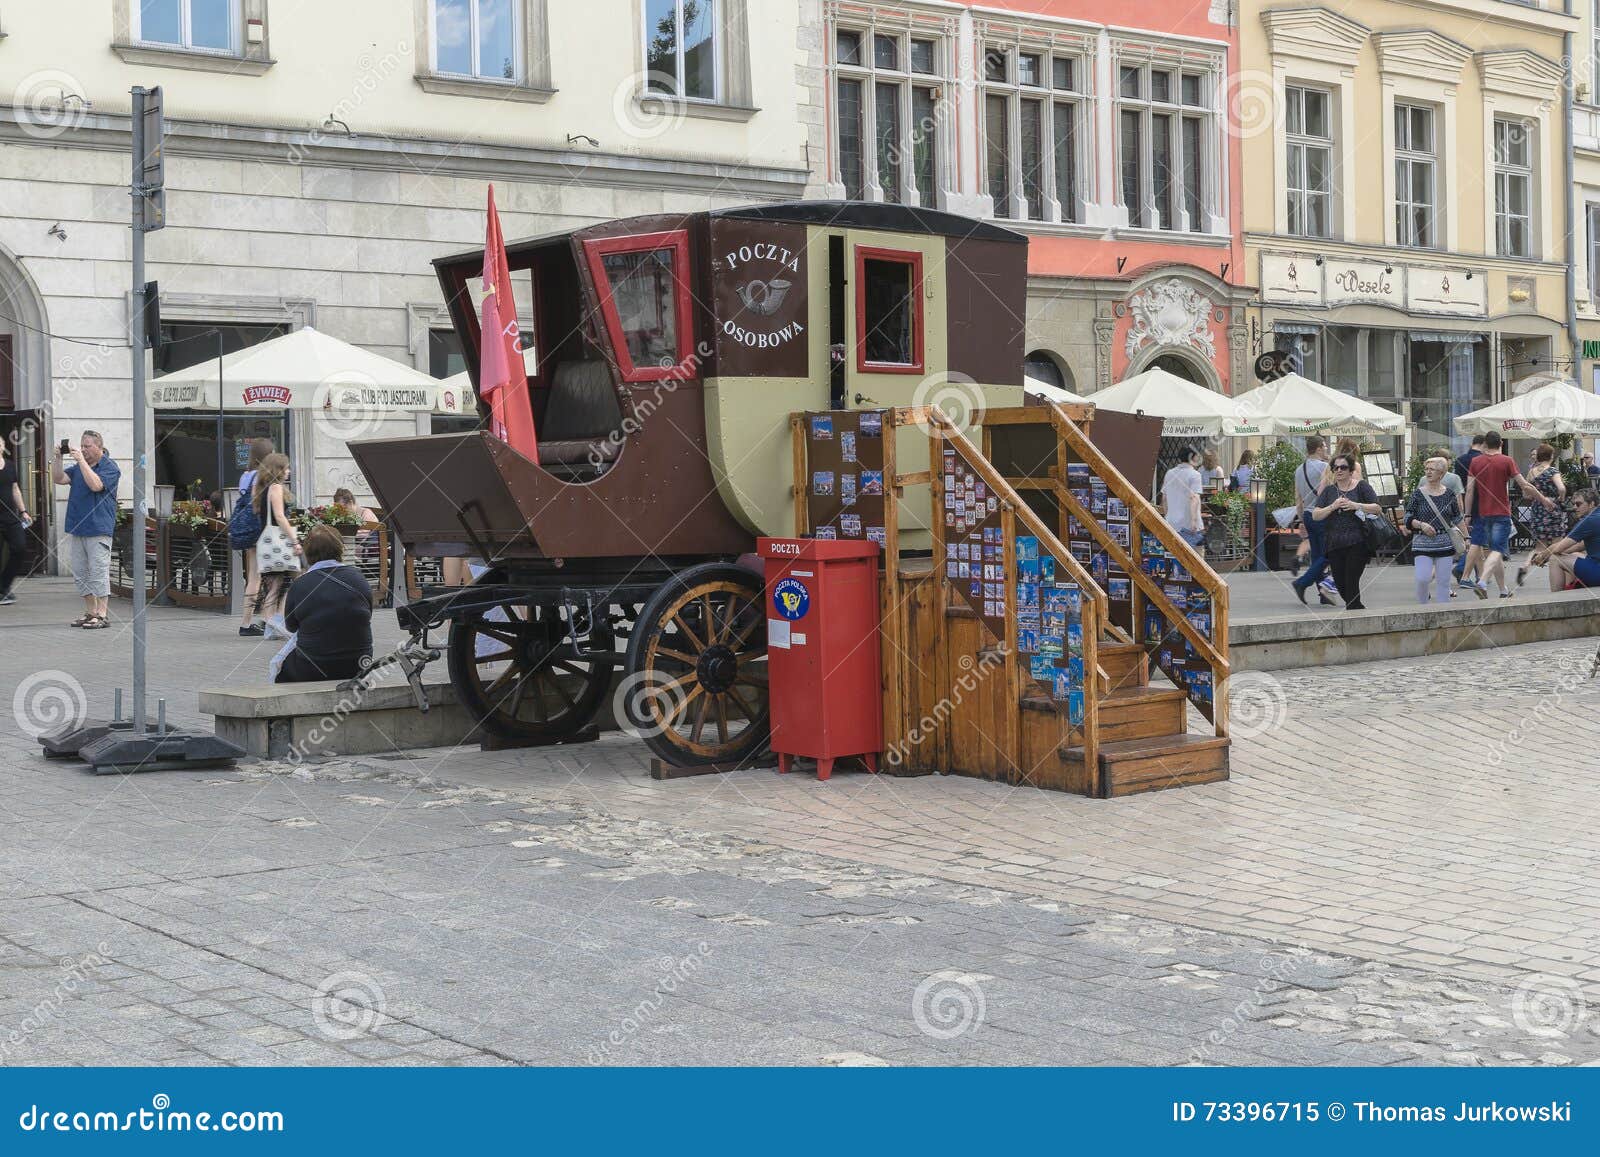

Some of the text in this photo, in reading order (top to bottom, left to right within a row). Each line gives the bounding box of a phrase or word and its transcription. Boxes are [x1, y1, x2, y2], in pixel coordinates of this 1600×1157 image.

[726, 243, 799, 272] POCZTA
[1335, 270, 1392, 294] Wesele
[723, 320, 804, 348] OSOBOWA
[249, 386, 286, 399] ŻYWIEC
[361, 389, 375, 405] KLUB
[377, 389, 388, 405] POD
[389, 389, 427, 406] JASZCZURAMI
[1289, 421, 1330, 433] Heineken
[771, 543, 801, 554] POCZTA
[774, 580, 808, 601] POCZTA POLSKA
